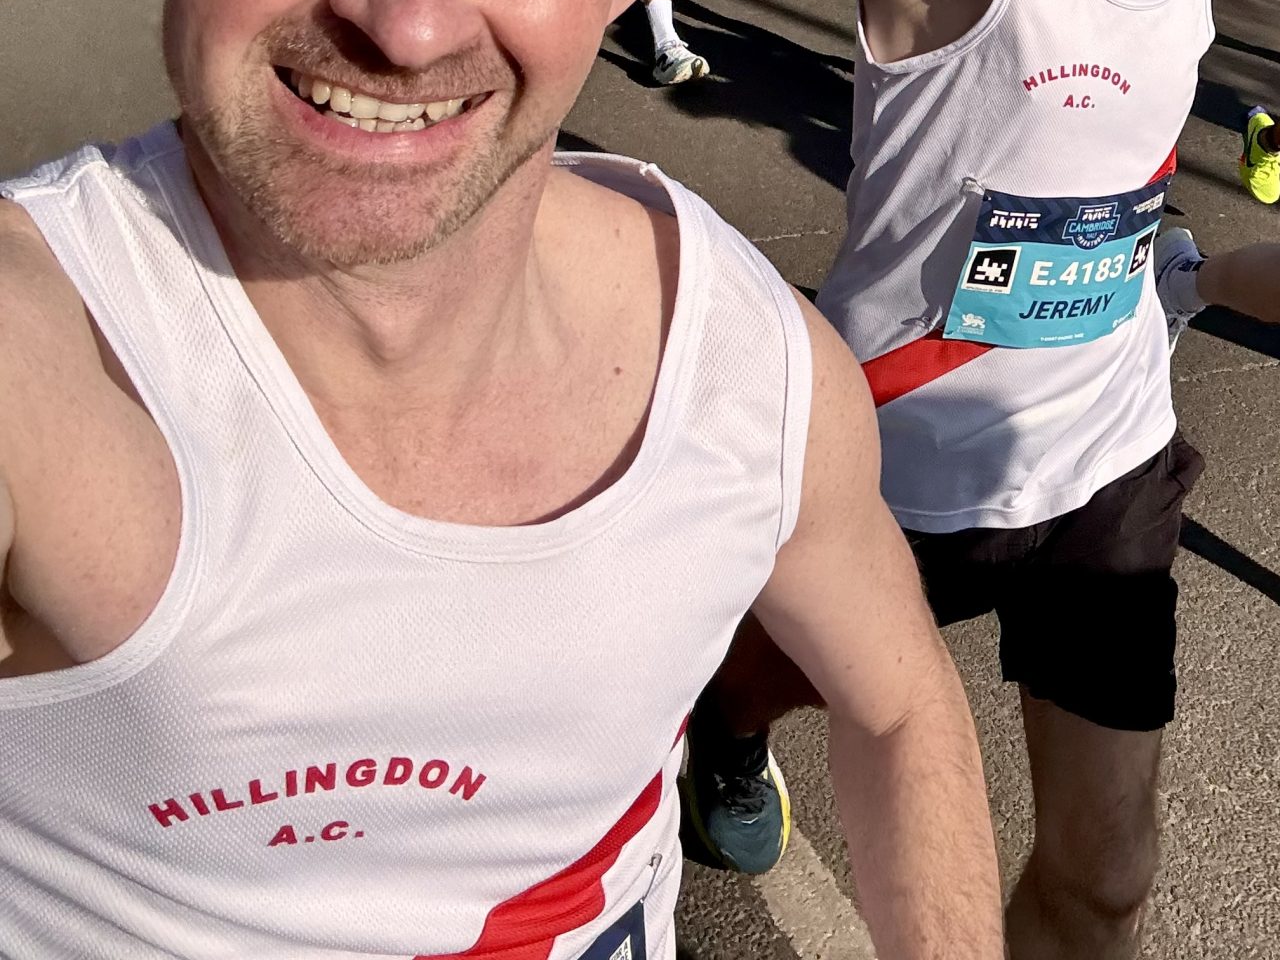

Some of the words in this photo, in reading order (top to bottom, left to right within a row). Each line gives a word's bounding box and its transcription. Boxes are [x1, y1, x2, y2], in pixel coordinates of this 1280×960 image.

[1022, 63, 1132, 95] HILLINGDON
[1063, 94, 1096, 109] A.C.
[1068, 218, 1116, 234] CAMBRIDGE
[1029, 253, 1126, 286] E.4183
[1018, 291, 1116, 320] JEREMY
[147, 756, 487, 829] HILLINGDON
[266, 819, 365, 848] A.C.
